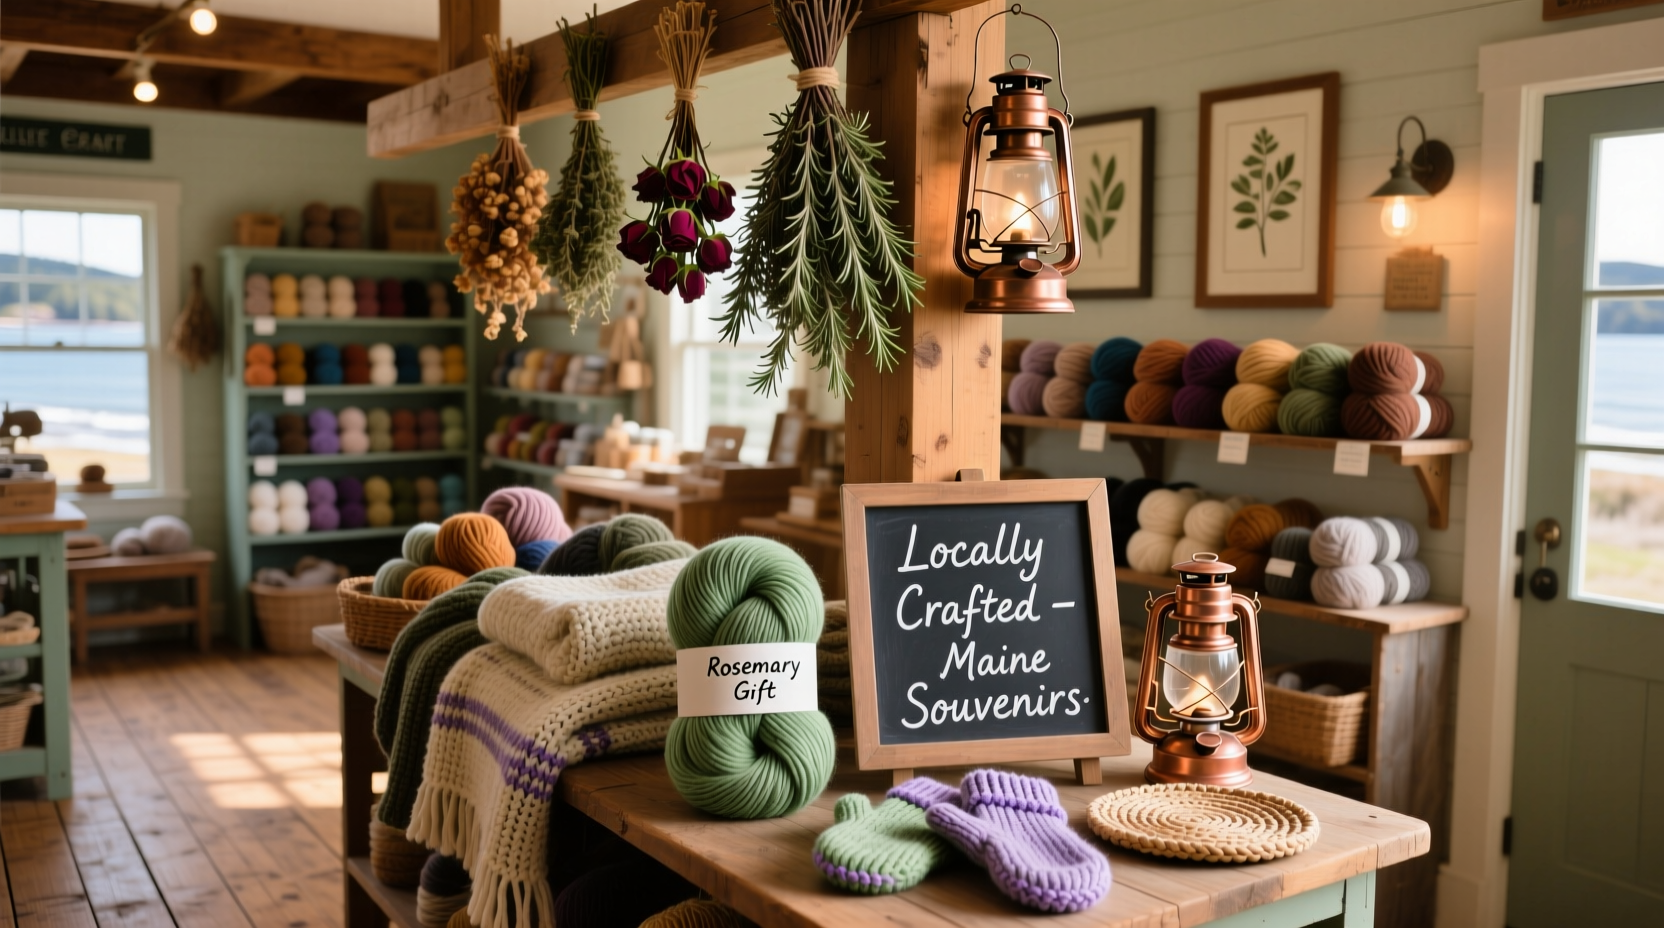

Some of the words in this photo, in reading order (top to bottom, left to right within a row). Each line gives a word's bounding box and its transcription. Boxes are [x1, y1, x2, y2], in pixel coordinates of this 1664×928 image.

[897, 522, 1044, 583] Locally
[896, 583, 1041, 640] Crafted
[706, 655, 801, 681] Rosemary
[939, 640, 1051, 682] Maine
[733, 679, 777, 706] Gift
